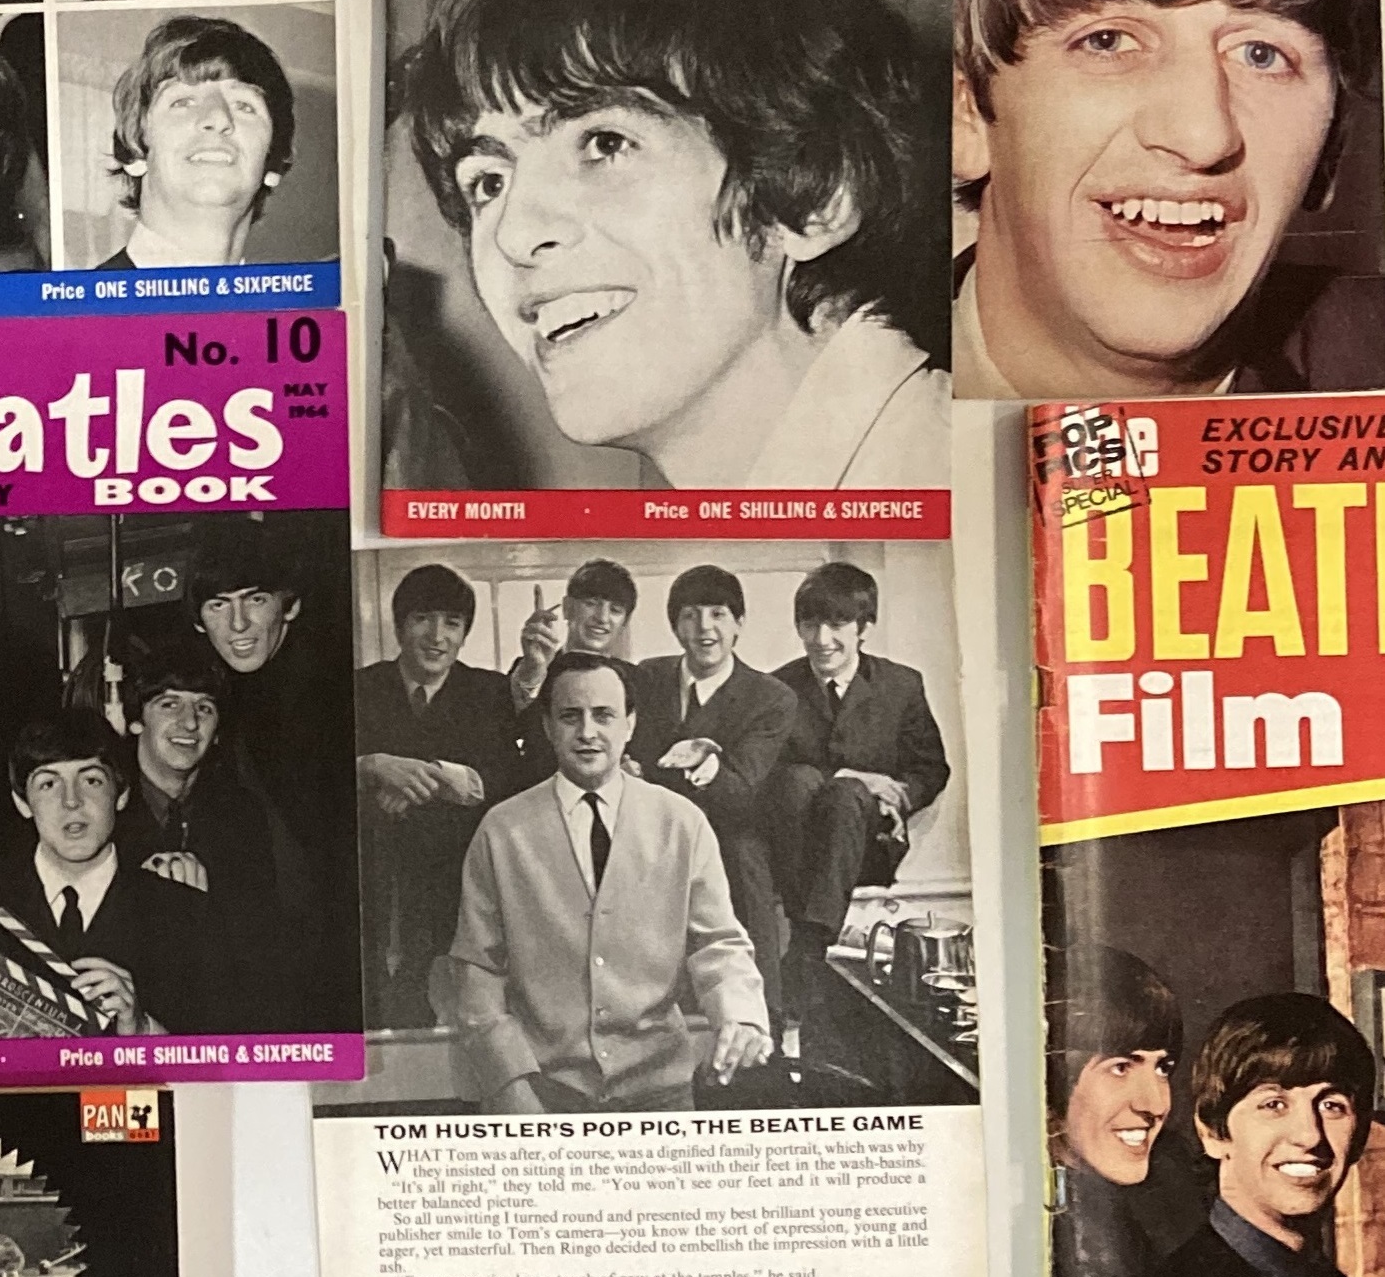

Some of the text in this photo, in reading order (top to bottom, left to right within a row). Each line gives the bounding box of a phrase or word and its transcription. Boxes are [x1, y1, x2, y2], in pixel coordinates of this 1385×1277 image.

[165, 317, 322, 366] No. 10
[1202, 448, 1321, 474] STORY
[94, 475, 278, 505] BOOK
[408, 503, 525, 519] EVERY MONTH
[644, 502, 922, 518] Price ONE SHILLING & SIXPENCE
[1066, 670, 1344, 774] Film
[83, 1105, 124, 1127] PAN
[374, 1115, 924, 1140] TOM HUSTLER'S POP PIC, THE BEATLE GAME
